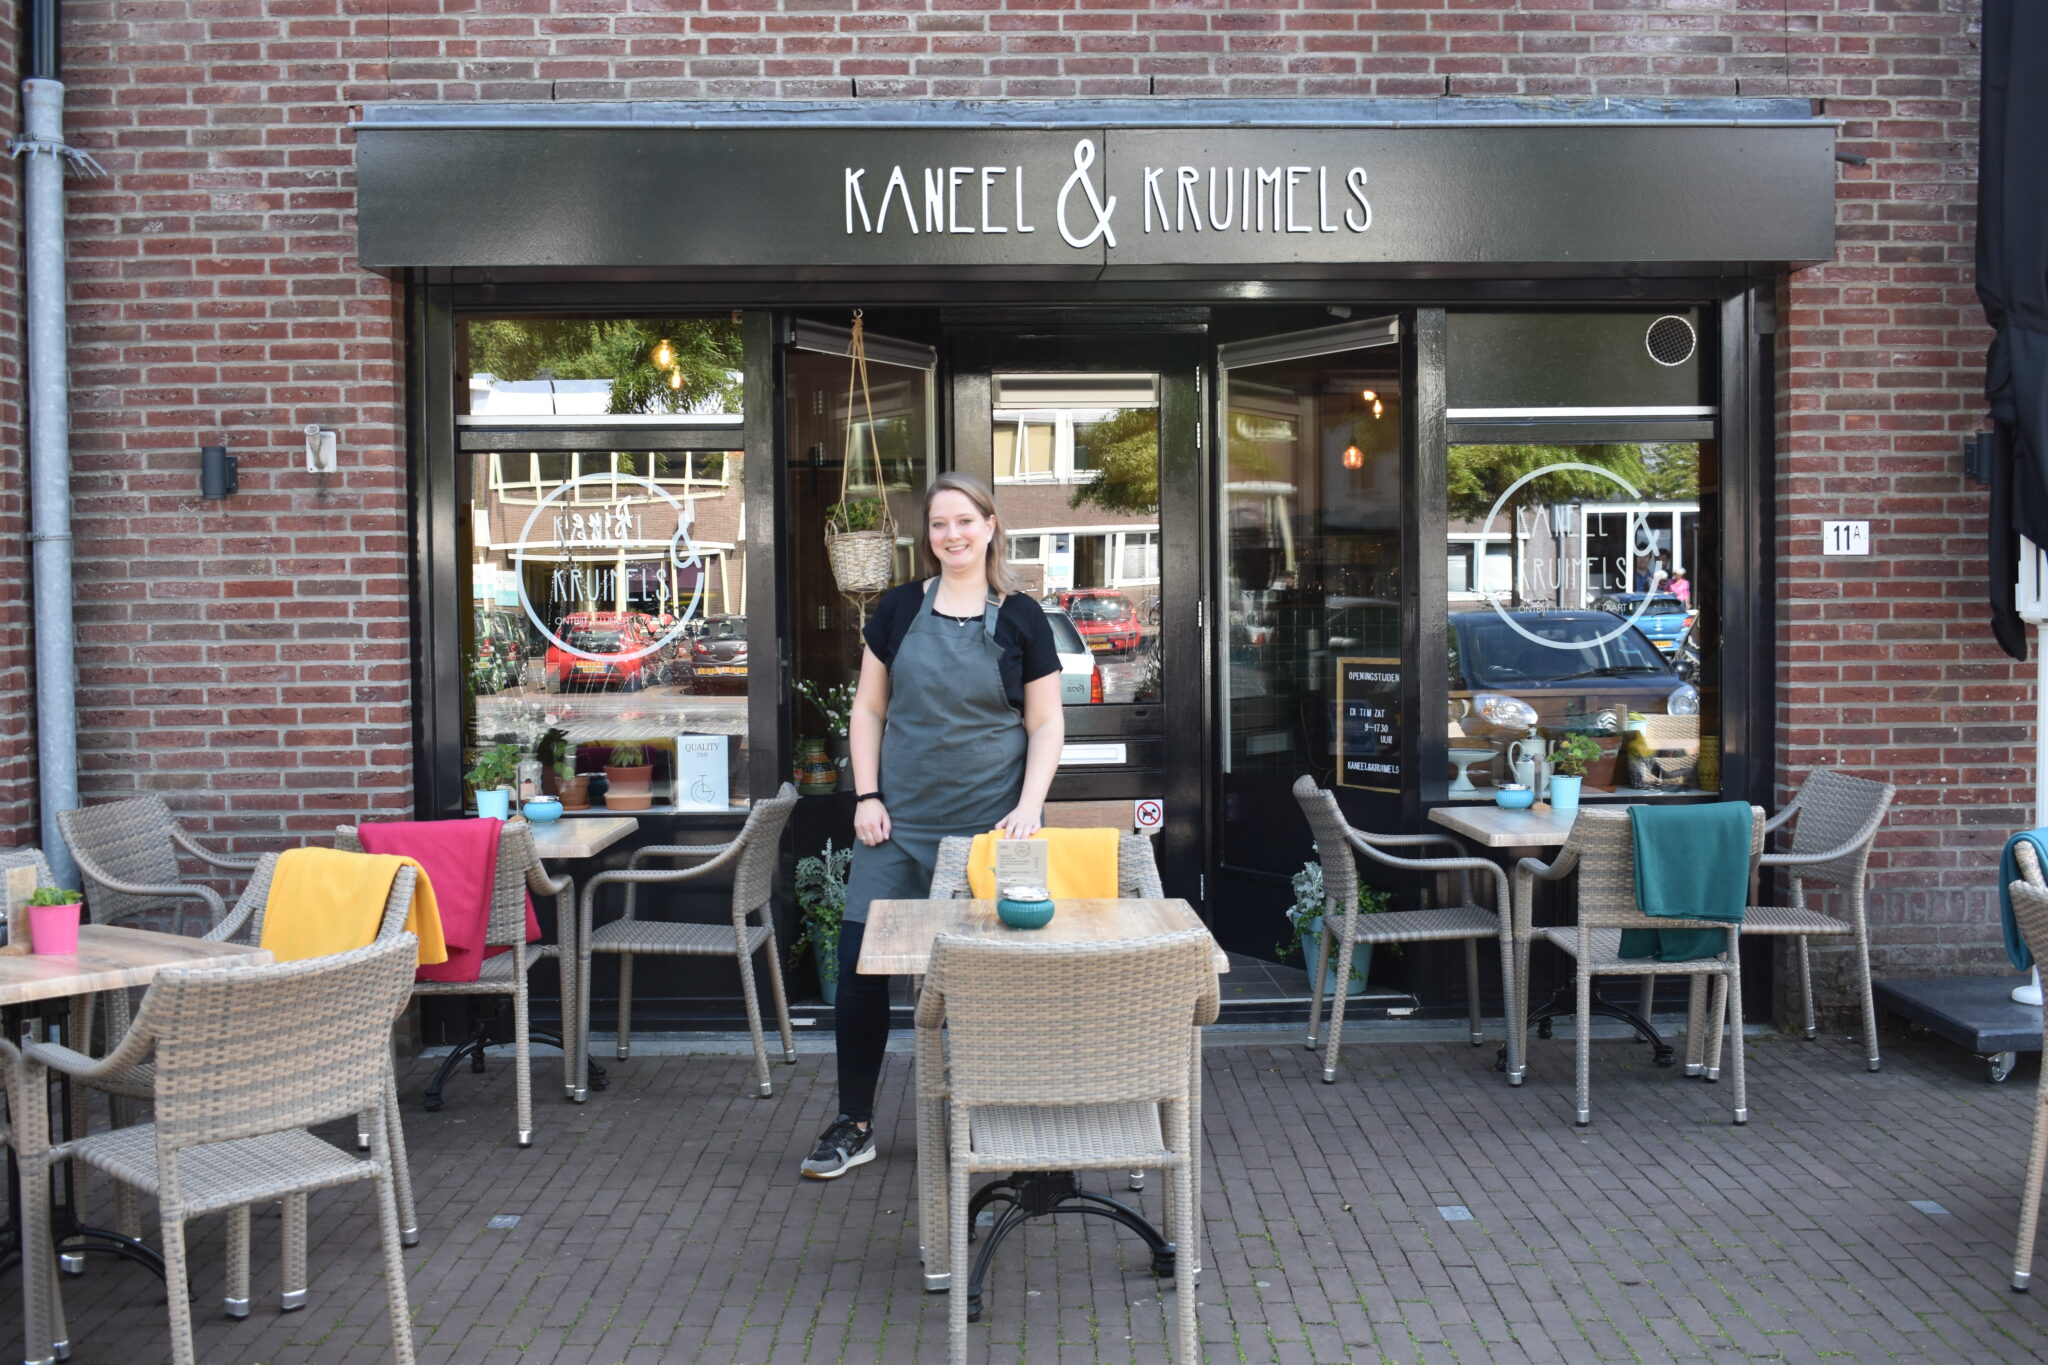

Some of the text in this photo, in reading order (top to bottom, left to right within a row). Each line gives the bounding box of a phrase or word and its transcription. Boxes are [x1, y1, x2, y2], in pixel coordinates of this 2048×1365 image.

[845, 138, 1373, 249] KANEEL & KRUIMELS
[1602, 603, 1628, 613] TAART
[1374, 709, 1386, 718] ZAT
[685, 743, 720, 752] QUALITY
